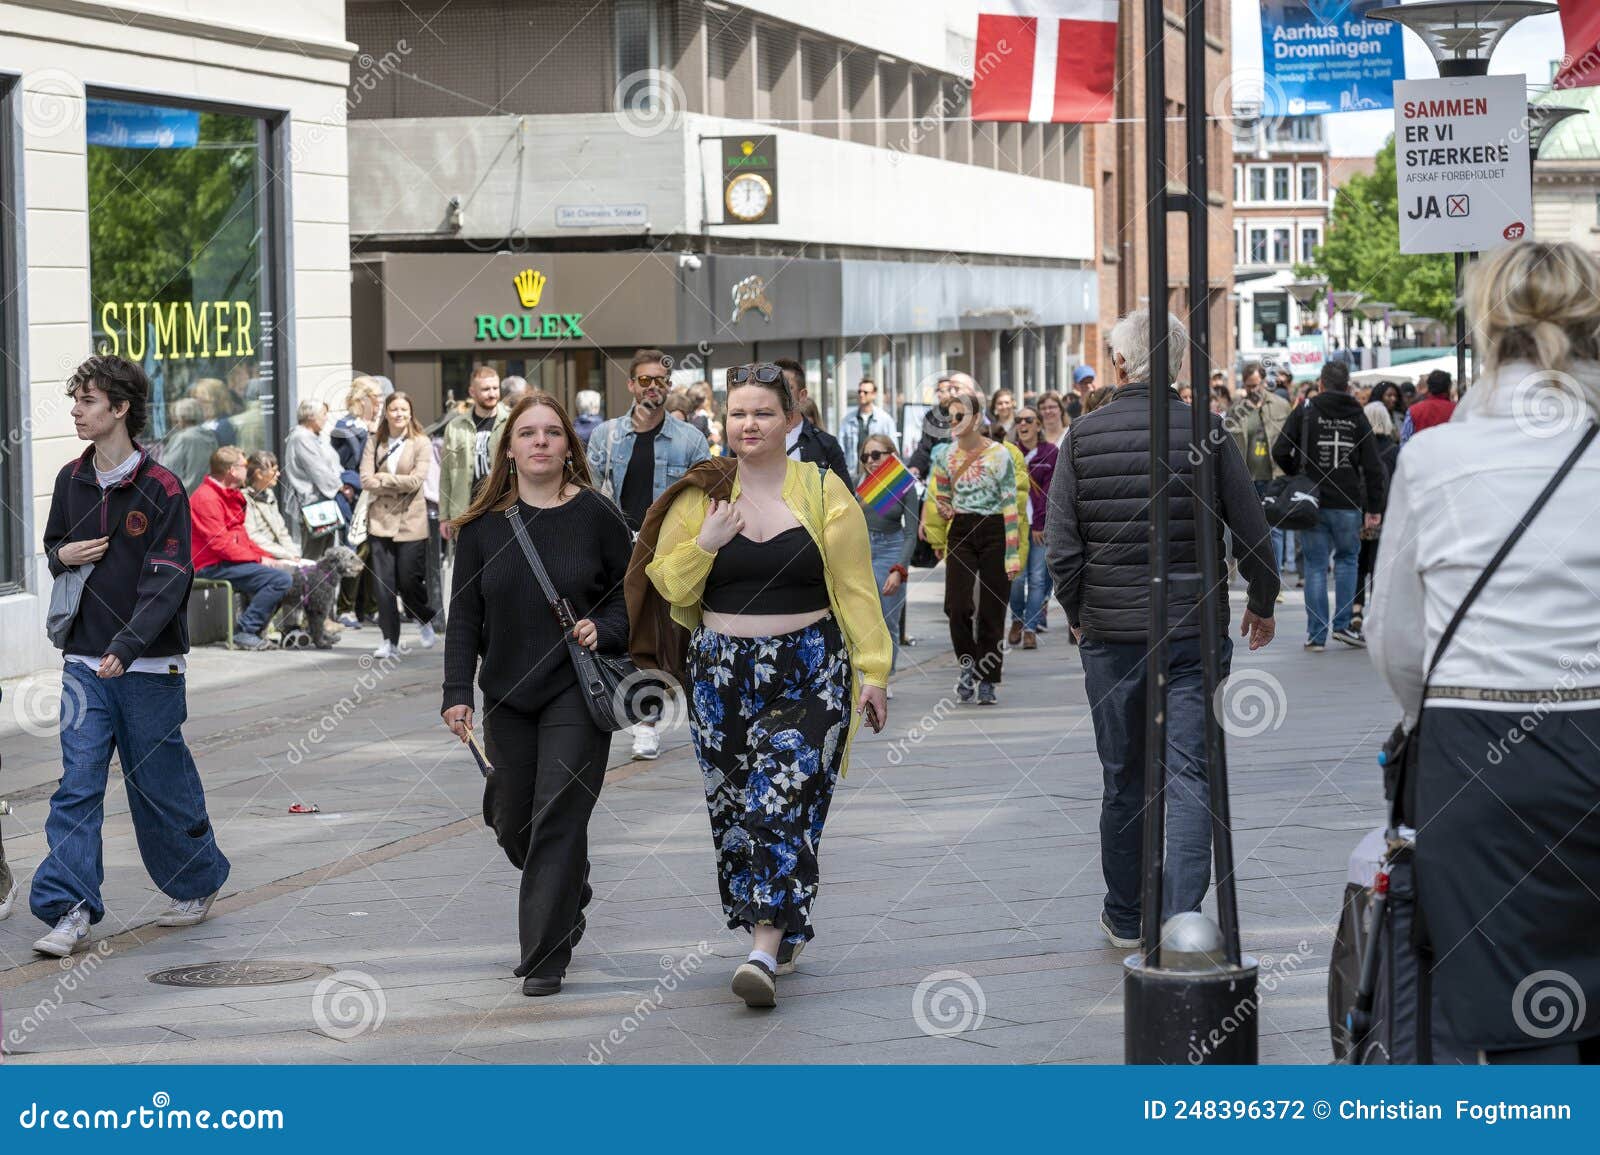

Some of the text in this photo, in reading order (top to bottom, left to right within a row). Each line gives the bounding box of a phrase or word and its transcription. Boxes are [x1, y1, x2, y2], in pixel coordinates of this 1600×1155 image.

[1273, 20, 1393, 41] Aarhus fejrer
[1274, 40, 1381, 58] Dronningen
[1404, 97, 1487, 119] SAMMEN
[1405, 124, 1453, 142] ER VI
[1406, 145, 1509, 166] STÆRKERE
[1406, 169, 1505, 183] AFSKAF FORBEHOLDET
[1408, 196, 1441, 220] JA
[1507, 227, 1524, 238] SF
[102, 301, 254, 361] SUMMER
[476, 313, 584, 339] ROLEX
